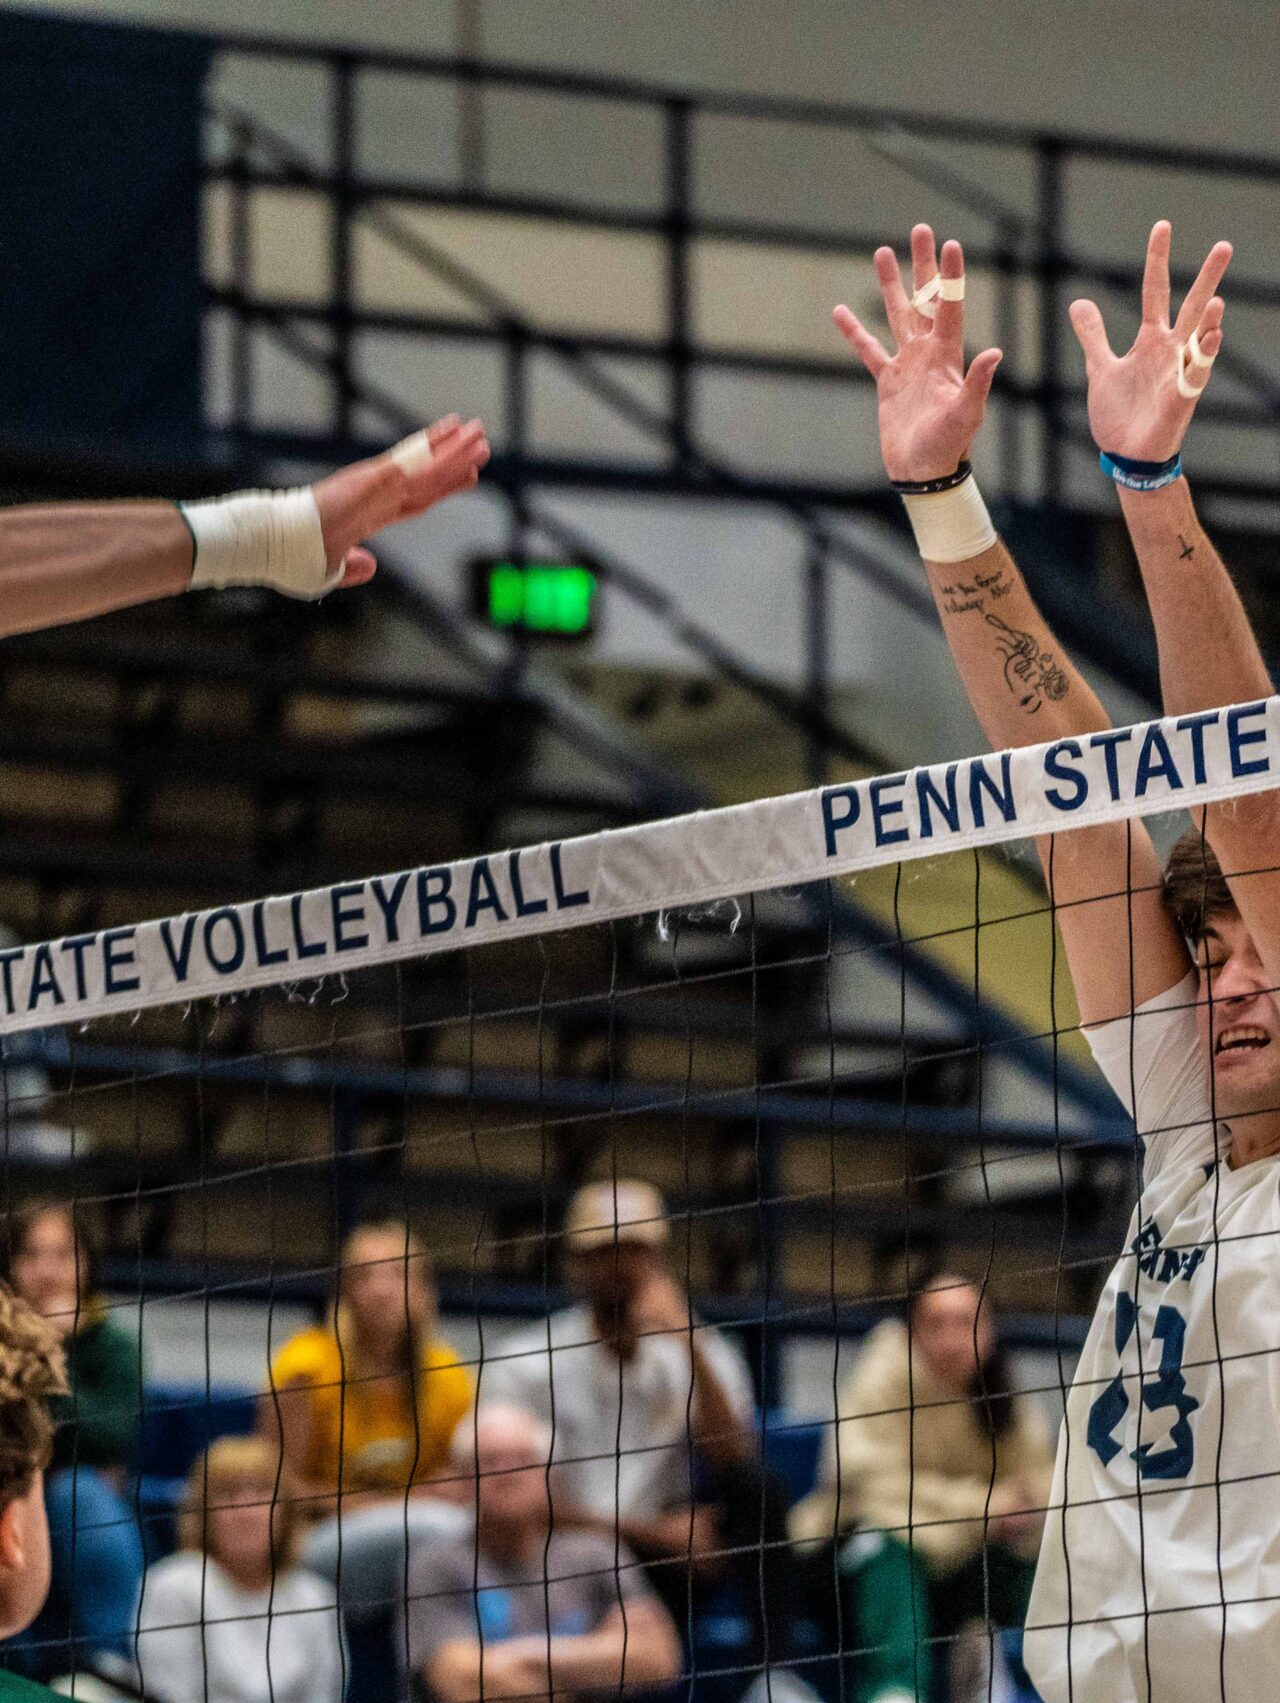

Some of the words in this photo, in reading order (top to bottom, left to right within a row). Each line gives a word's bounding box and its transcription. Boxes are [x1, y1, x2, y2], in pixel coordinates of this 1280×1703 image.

[820, 753, 1017, 857] PENN
[1044, 702, 1270, 811] STATE
[0, 928, 139, 1014] TATE
[160, 843, 590, 982] VOLLEYBALL
